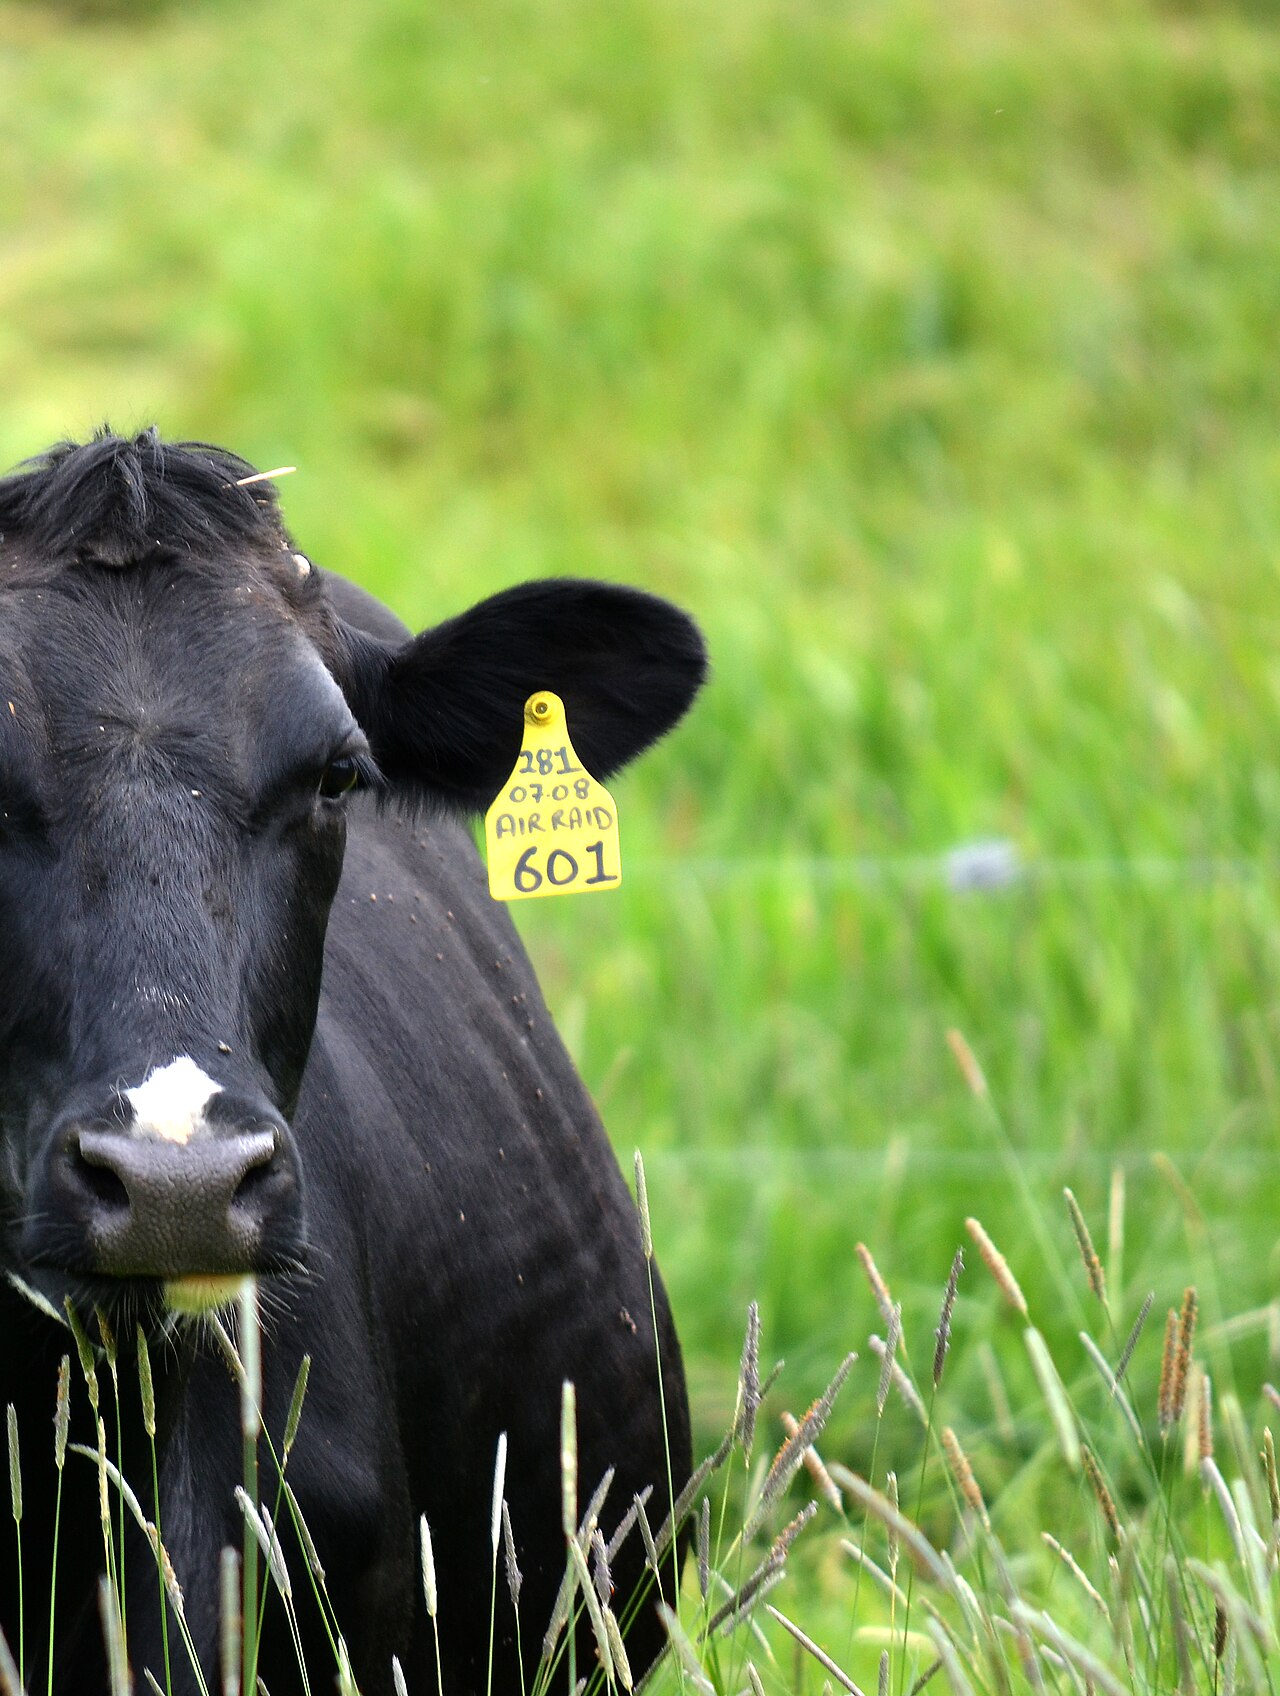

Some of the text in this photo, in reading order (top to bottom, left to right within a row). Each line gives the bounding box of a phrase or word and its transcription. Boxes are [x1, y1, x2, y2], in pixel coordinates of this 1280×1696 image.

[519, 746, 583, 775] 281
[496, 806, 613, 839] AIR RAID
[514, 840, 618, 893] 601
